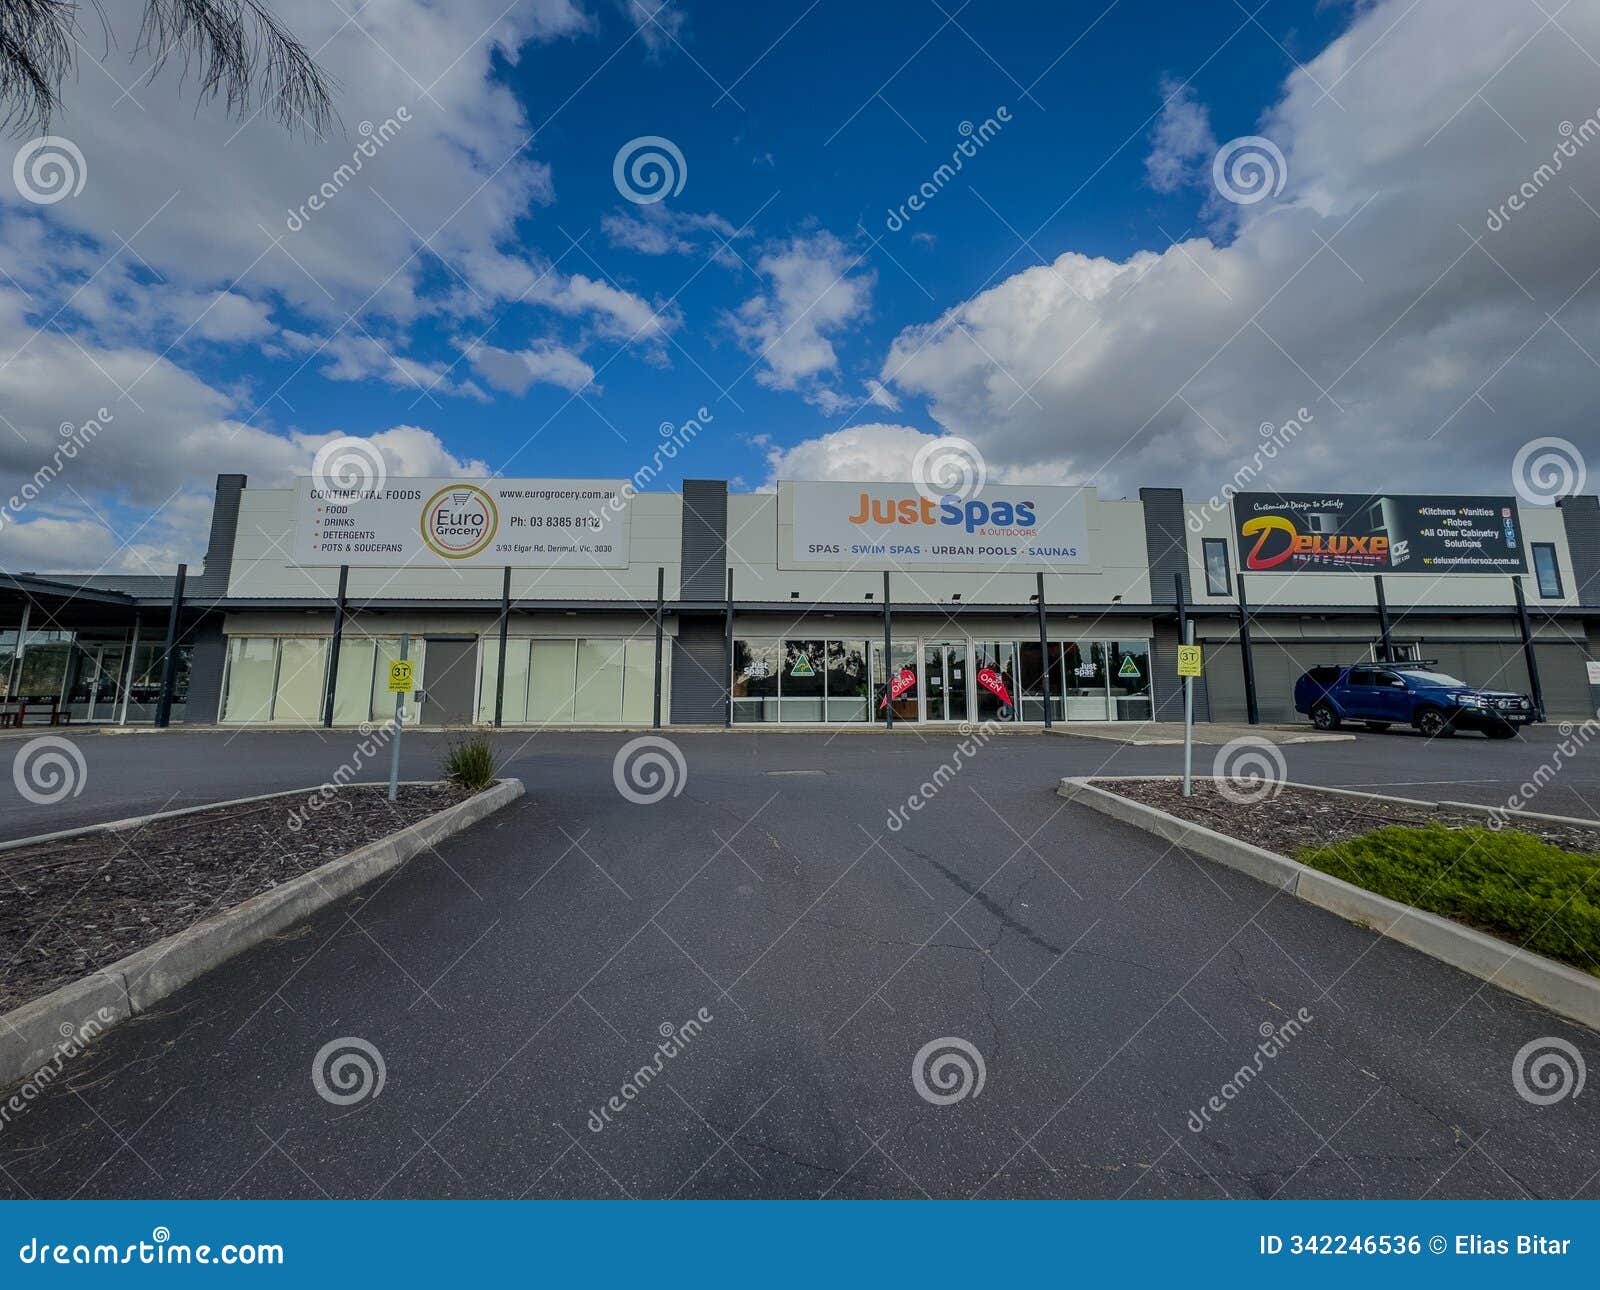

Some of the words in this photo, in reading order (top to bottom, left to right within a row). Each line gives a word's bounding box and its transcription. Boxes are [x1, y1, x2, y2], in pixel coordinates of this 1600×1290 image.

[310, 489, 382, 500] CONTINENTAL
[386, 490, 421, 500] FOODS
[499, 489, 616, 501] www.eurogrocery.com.au
[325, 505, 348, 514] FOOD
[1290, 500, 1311, 511] Design
[1312, 500, 1320, 508] to
[1321, 498, 1344, 509] Satisfy
[1422, 507, 1457, 517] Kitchens
[1462, 507, 1495, 517] Vanities
[324, 518, 355, 527] DRINKS
[437, 509, 484, 526] Euro
[510, 516, 527, 527] Ph:
[530, 516, 543, 527] 03
[546, 516, 572, 528] 8385
[1447, 518, 1473, 527] Robes
[323, 530, 376, 540] DETERGENTS
[436, 526, 483, 538] Grocery
[979, 528, 986, 536] &
[987, 528, 1038, 537] OUTDOORS
[1424, 529, 1435, 537] All
[1436, 529, 1459, 537] Other
[1461, 529, 1500, 540] Cabinetry
[321, 543, 343, 552] POTS
[345, 544, 351, 552] &
[354, 543, 403, 553] SOUCEPANS
[1444, 539, 1482, 548] Solutions
[496, 544, 512, 552] 3/93
[514, 544, 532, 554] Elgar
[594, 545, 613, 553] 3030
[808, 544, 840, 553] SPAS
[851, 545, 886, 554] SWIM
[889, 545, 921, 554] SPAS
[931, 546, 974, 556] URBAN
[978, 546, 1017, 556] POOLS
[1028, 547, 1077, 557] SAUNAS
[1182, 652, 1197, 661] 3T
[394, 667, 409, 677] 3T
[892, 675, 913, 693] OPEN
[980, 673, 1002, 692] OPEN
